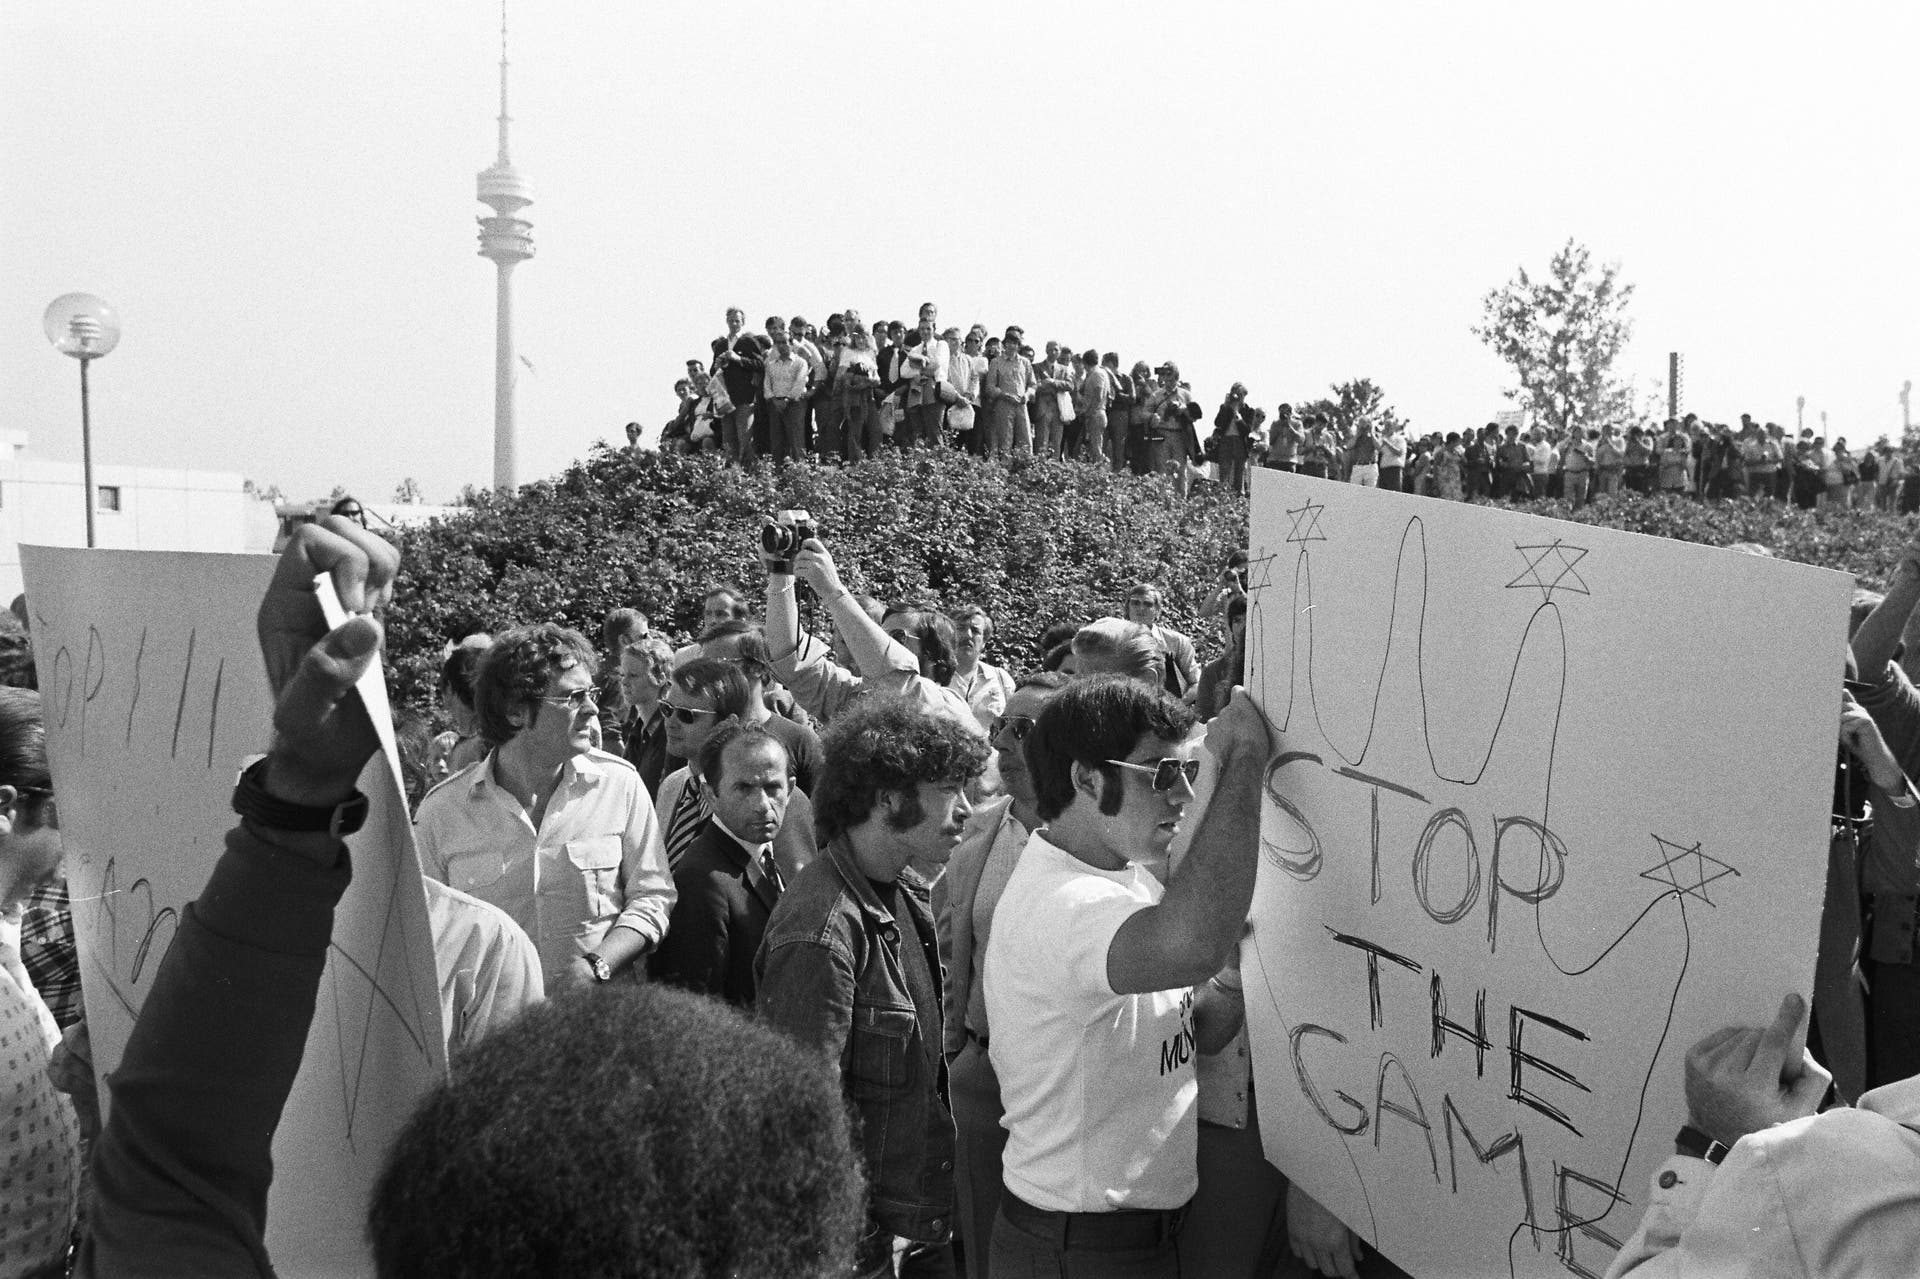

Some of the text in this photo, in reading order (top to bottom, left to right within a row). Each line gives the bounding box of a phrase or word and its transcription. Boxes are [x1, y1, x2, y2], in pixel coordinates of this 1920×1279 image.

[1262, 751, 1568, 953] STOP
[1320, 924, 1592, 1138] THE
[1289, 1022, 1632, 1279] GAME
